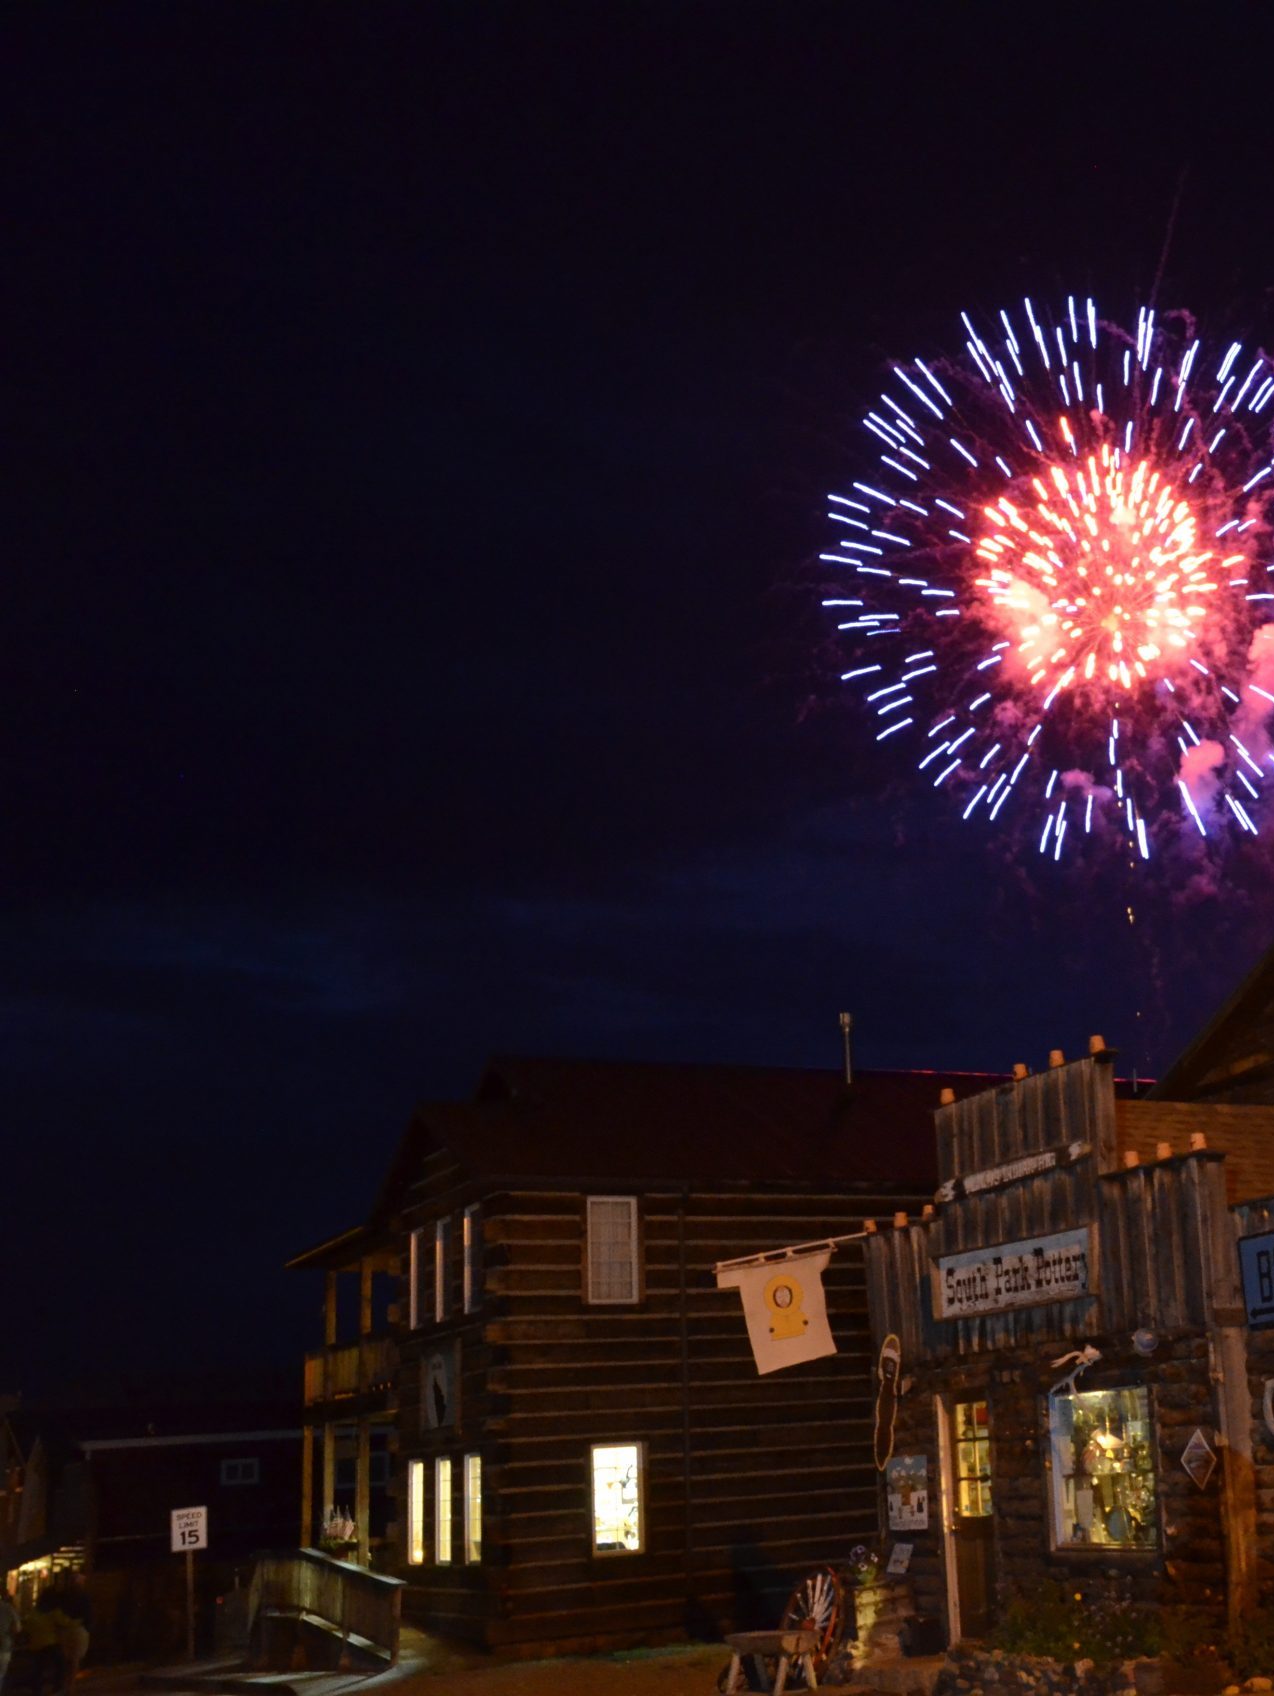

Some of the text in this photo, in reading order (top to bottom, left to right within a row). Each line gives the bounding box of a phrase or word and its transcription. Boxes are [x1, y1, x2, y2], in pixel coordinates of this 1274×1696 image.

[946, 1247, 1088, 1305] South Park Pottery
[176, 1511, 202, 1520] SPEED
[178, 1520, 199, 1529] LIMIT
[180, 1529, 200, 1546] 15
